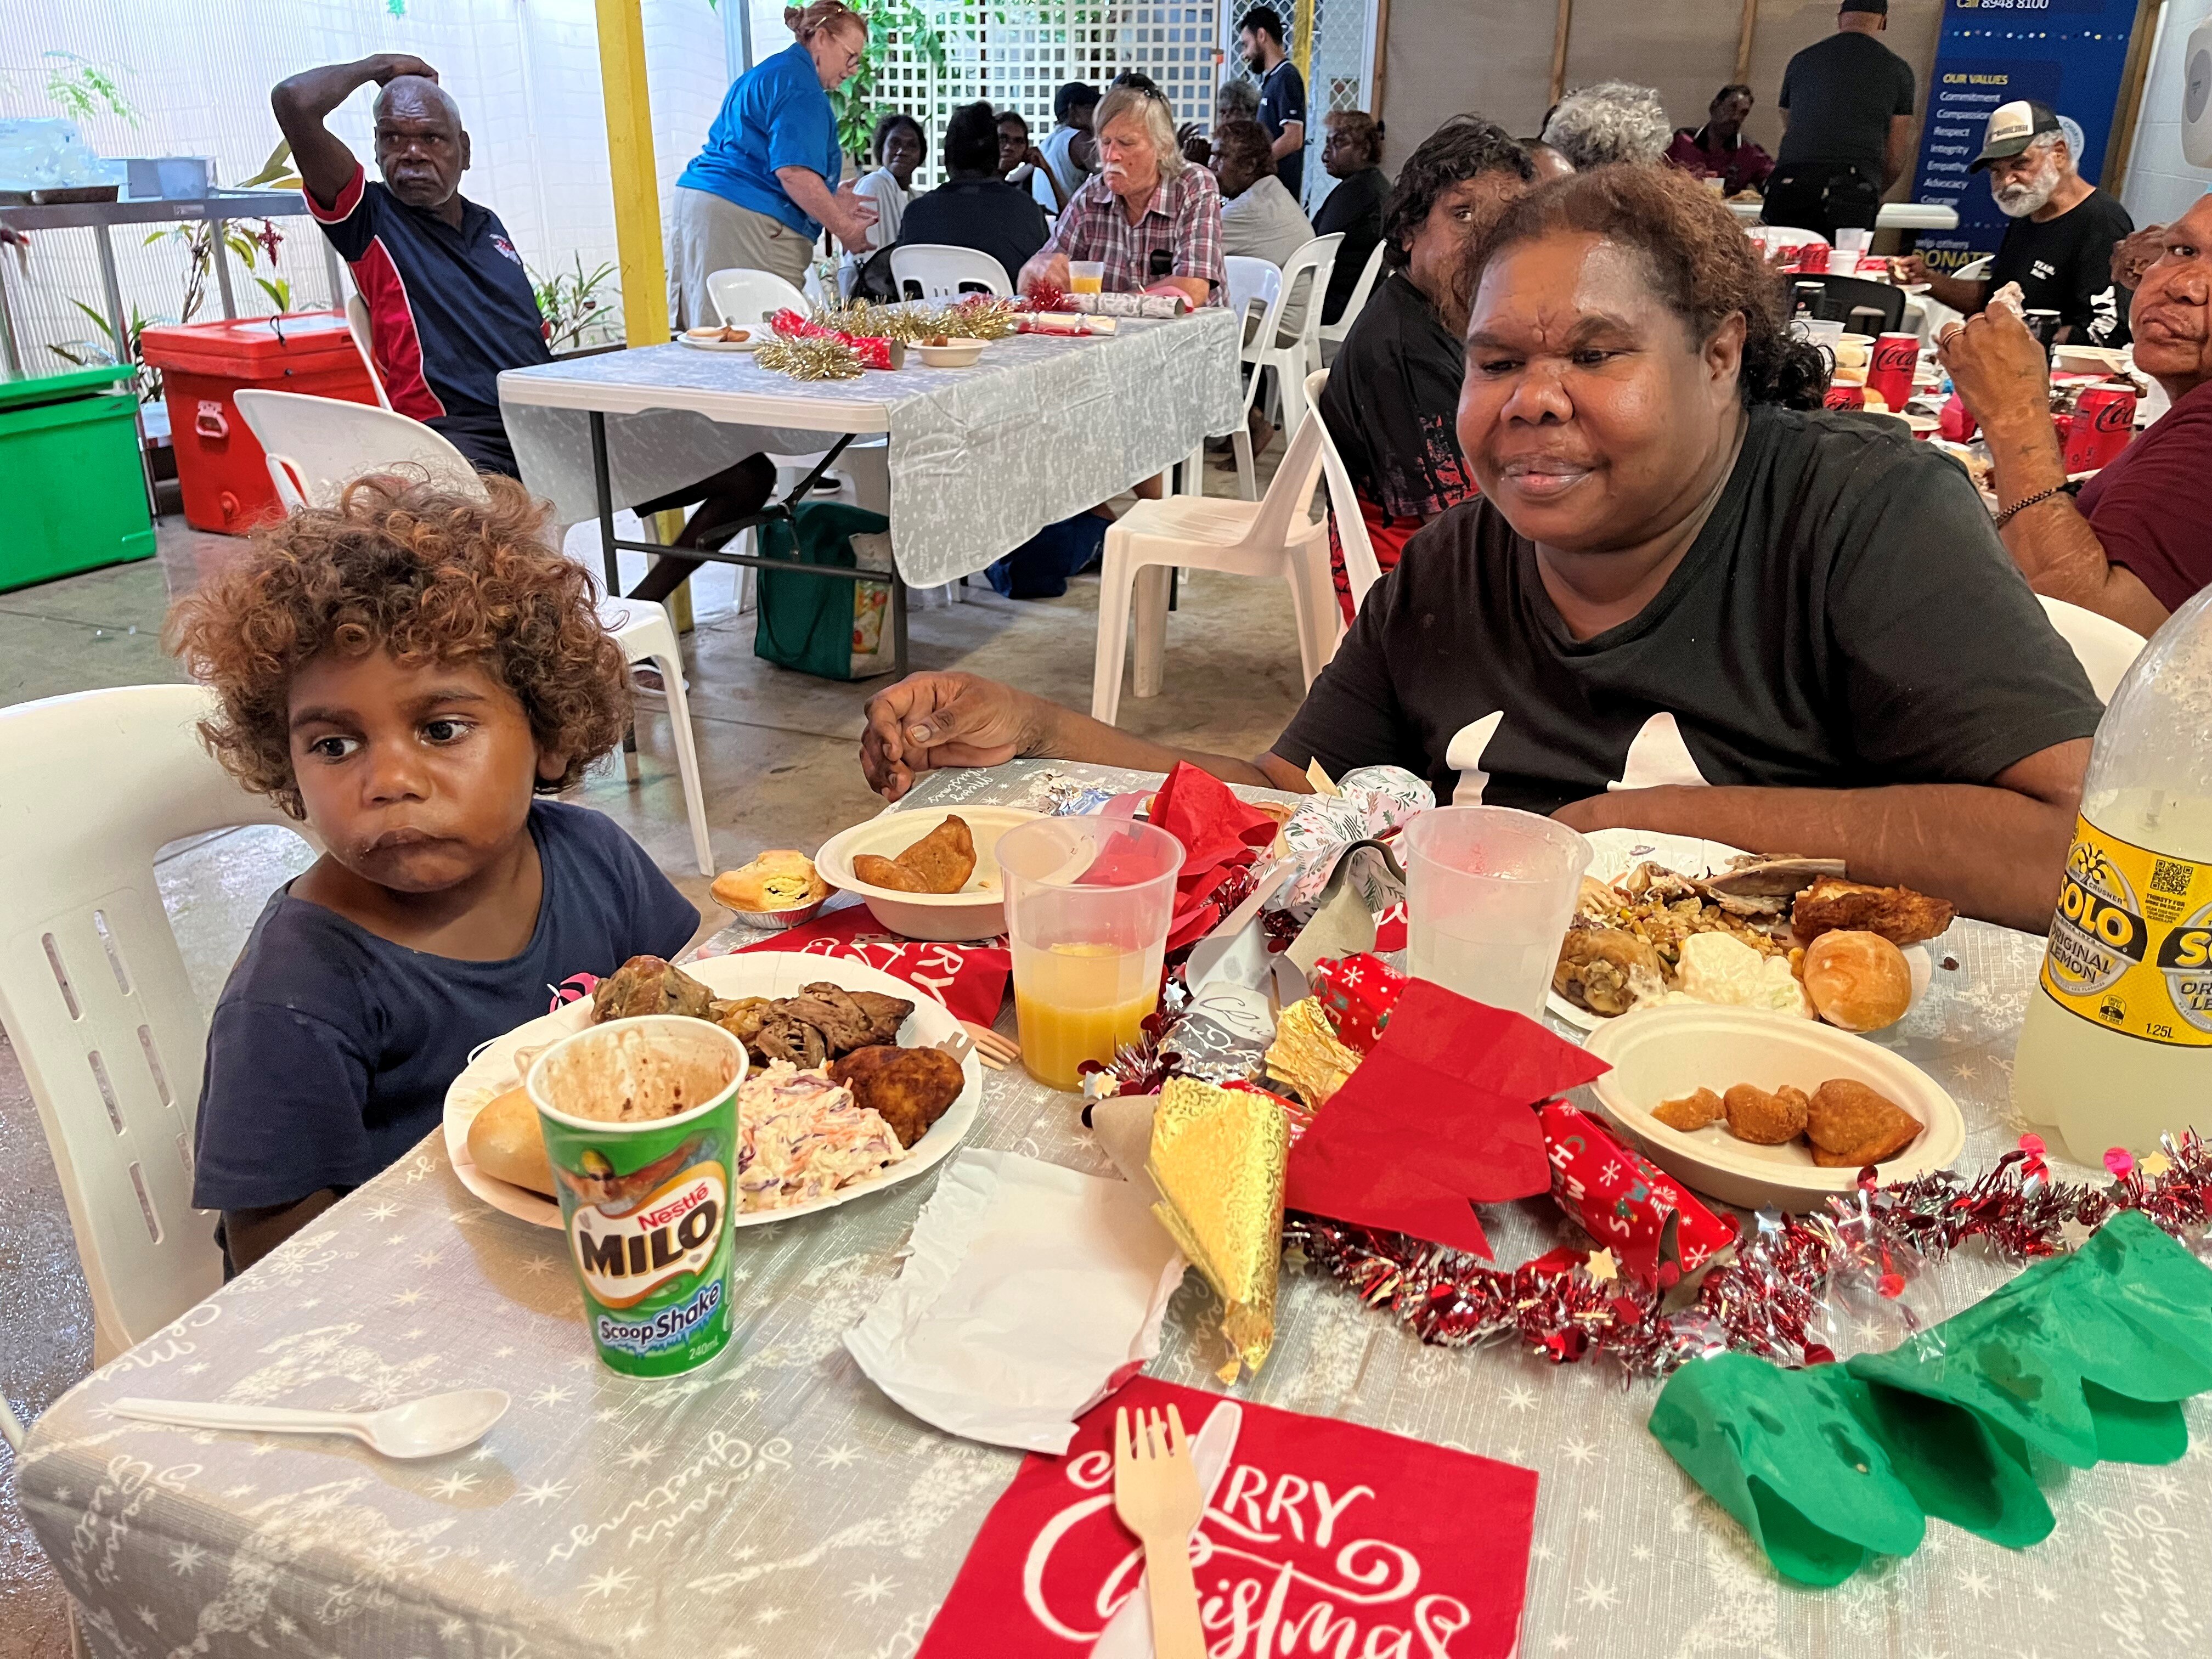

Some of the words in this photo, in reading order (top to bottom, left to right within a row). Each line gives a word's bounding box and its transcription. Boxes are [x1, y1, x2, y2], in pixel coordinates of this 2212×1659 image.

[1943, 74, 1967, 83] OUR
[1968, 75, 2008, 85] VALUES
[1939, 91, 2001, 103] Commitment
[1933, 126, 1970, 137] Respect
[1930, 144, 1970, 156] Integrity
[1927, 160, 1968, 173] Empathy
[1922, 178, 1970, 191] Advocacy
[950, 775, 994, 802] Merry
[2089, 882, 2123, 905] CRUSHER
[2052, 922, 2110, 975] ORIGINAL
[2049, 941, 2097, 984] LEMON
[2146, 1023, 2174, 1039] 1.25L
[637, 1181, 710, 1232] Nestlé
[579, 1199, 718, 1277] MILO
[601, 1321, 654, 1345] Scoop
[657, 1283, 720, 1338] Shake
[545, 1429, 754, 1567] Greetings
